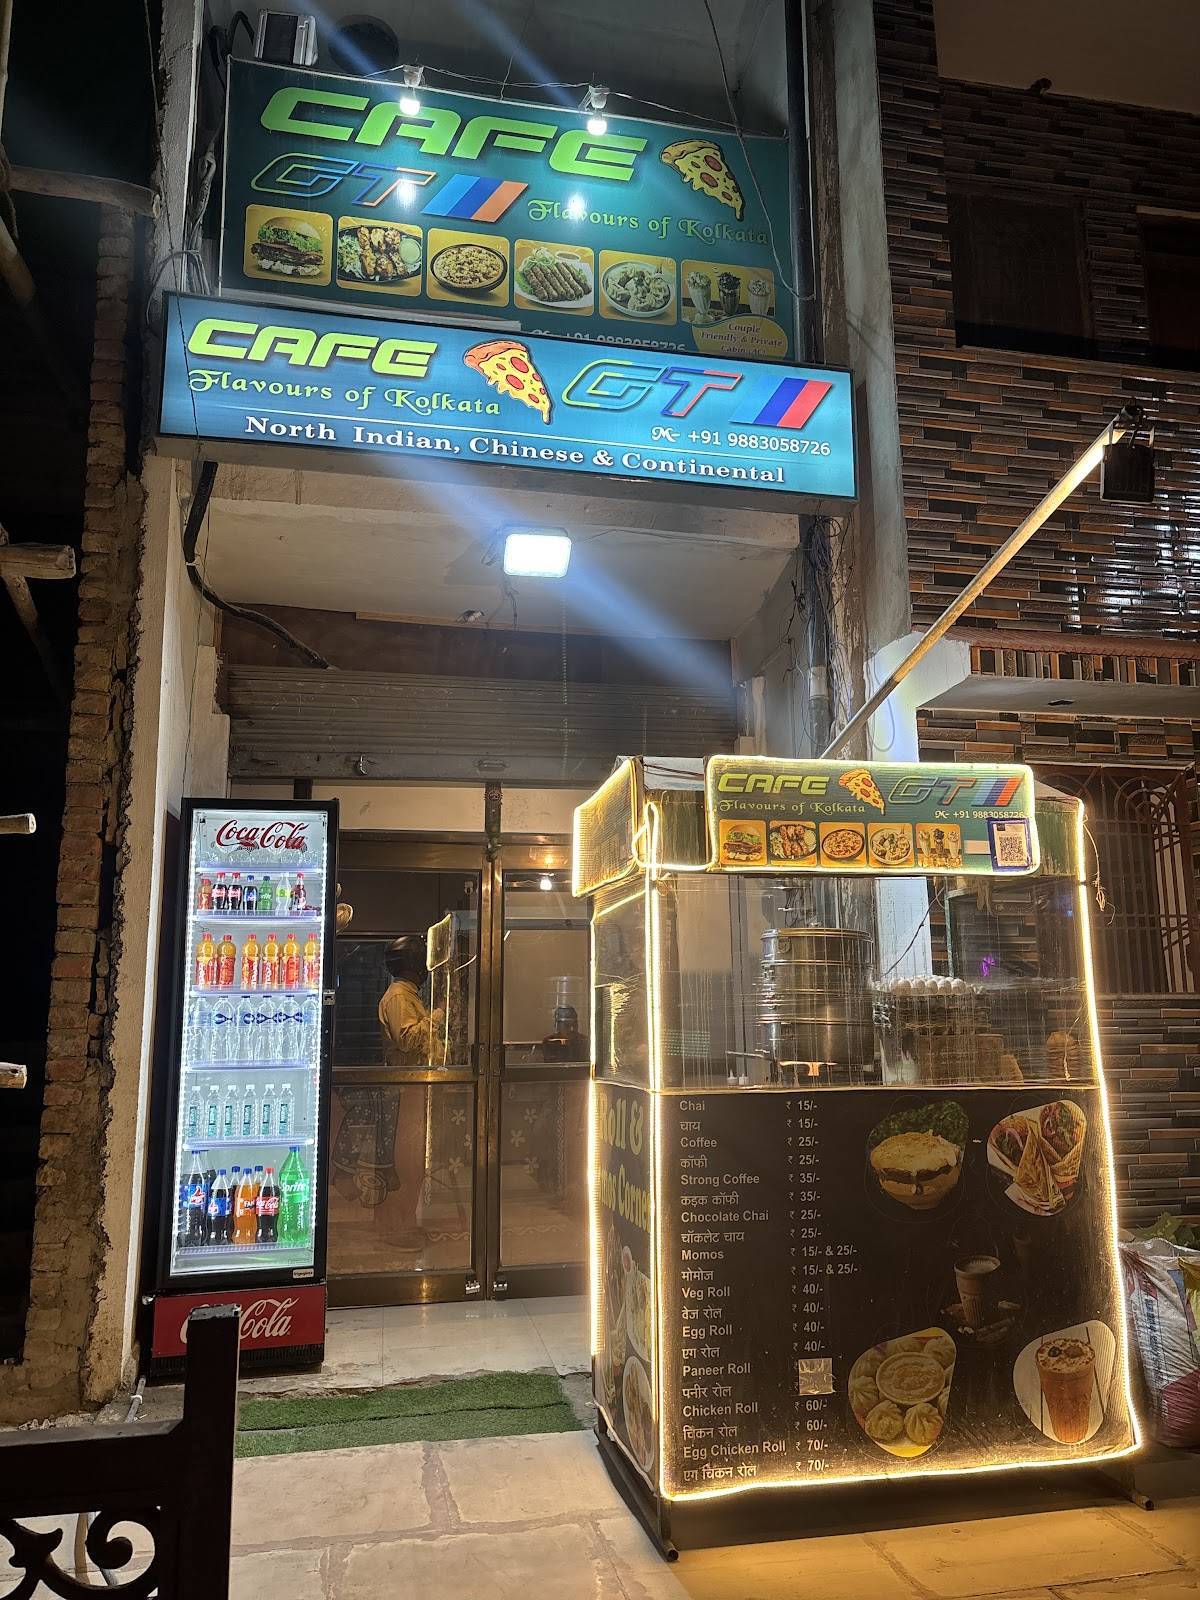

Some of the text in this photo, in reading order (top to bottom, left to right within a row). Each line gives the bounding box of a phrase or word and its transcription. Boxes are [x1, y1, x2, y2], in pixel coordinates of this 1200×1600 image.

[261, 87, 648, 181] CAFE
[528, 200, 769, 245] Flavours of Kolkata
[728, 323, 760, 334] Couple
[701, 332, 737, 343] Friendly
[751, 336, 783, 347] Private
[188, 319, 437, 377] CAFE
[188, 370, 500, 415] Flavours of Kolkata
[245, 416, 785, 483] North Indian, Chinese & Continental
[688, 430, 721, 446] +91
[728, 432, 831, 456] 9883058726
[718, 773, 830, 795] CAFE
[719, 799, 865, 815] Flavours of Kolkata
[952, 810, 970, 819] +91
[972, 810, 1024, 819] 9883058726
[216, 819, 310, 850] Coca-Cola
[679, 1100, 705, 1111] Chai
[798, 1100, 818, 1111] 15/-
[629, 1100, 643, 1156] &
[680, 1120, 701, 1131] चाय
[798, 1118, 818, 1129] 15/-
[680, 1137, 717, 1148] Coffee
[798, 1136, 819, 1147] 25/-
[680, 1154, 708, 1168] कॉफी
[799, 1154, 820, 1165] 25/-
[680, 1173, 760, 1187] Strong Coffee
[800, 1173, 820, 1183] 35/-
[711, 1191, 739, 1205] कॉफी
[800, 1191, 821, 1201] 35/-
[681, 1210, 769, 1223] Chocolate Chai
[801, 1209, 821, 1220] 25/-
[680, 1229, 744, 1244] चॉकलेट चाय
[801, 1228, 822, 1238] 25/-
[681, 1250, 724, 1260] Momos
[802, 1246, 822, 1257] 15/-
[825, 1245, 834, 1256] &
[837, 1245, 857, 1256] 25/-
[681, 1267, 714, 1281] मोमोज
[802, 1265, 823, 1275] 15/-
[826, 1264, 834, 1274] &
[838, 1263, 858, 1274] 25/-
[681, 1286, 730, 1300] Veg Roll
[802, 1283, 823, 1294] 40/-
[681, 1304, 722, 1320] वेज रोल
[803, 1302, 824, 1313] 40/-
[682, 1324, 732, 1339] Egg Roll
[803, 1321, 825, 1332] 40/-
[682, 1344, 720, 1359] एग रोल
[804, 1341, 825, 1352] 40/-
[683, 1362, 751, 1377] Paneer Roll
[682, 1382, 732, 1398] पनीर रोल
[683, 1402, 758, 1417] Chicken Roll
[805, 1399, 827, 1411] 60/-
[683, 1422, 737, 1440] चिकन रोल
[806, 1419, 828, 1431] 60/-
[683, 1440, 786, 1460] Egg Chicken Roll
[807, 1439, 829, 1451] 70/-
[684, 1462, 757, 1482] एग चिकन रोल
[807, 1459, 830, 1472] 70/-
